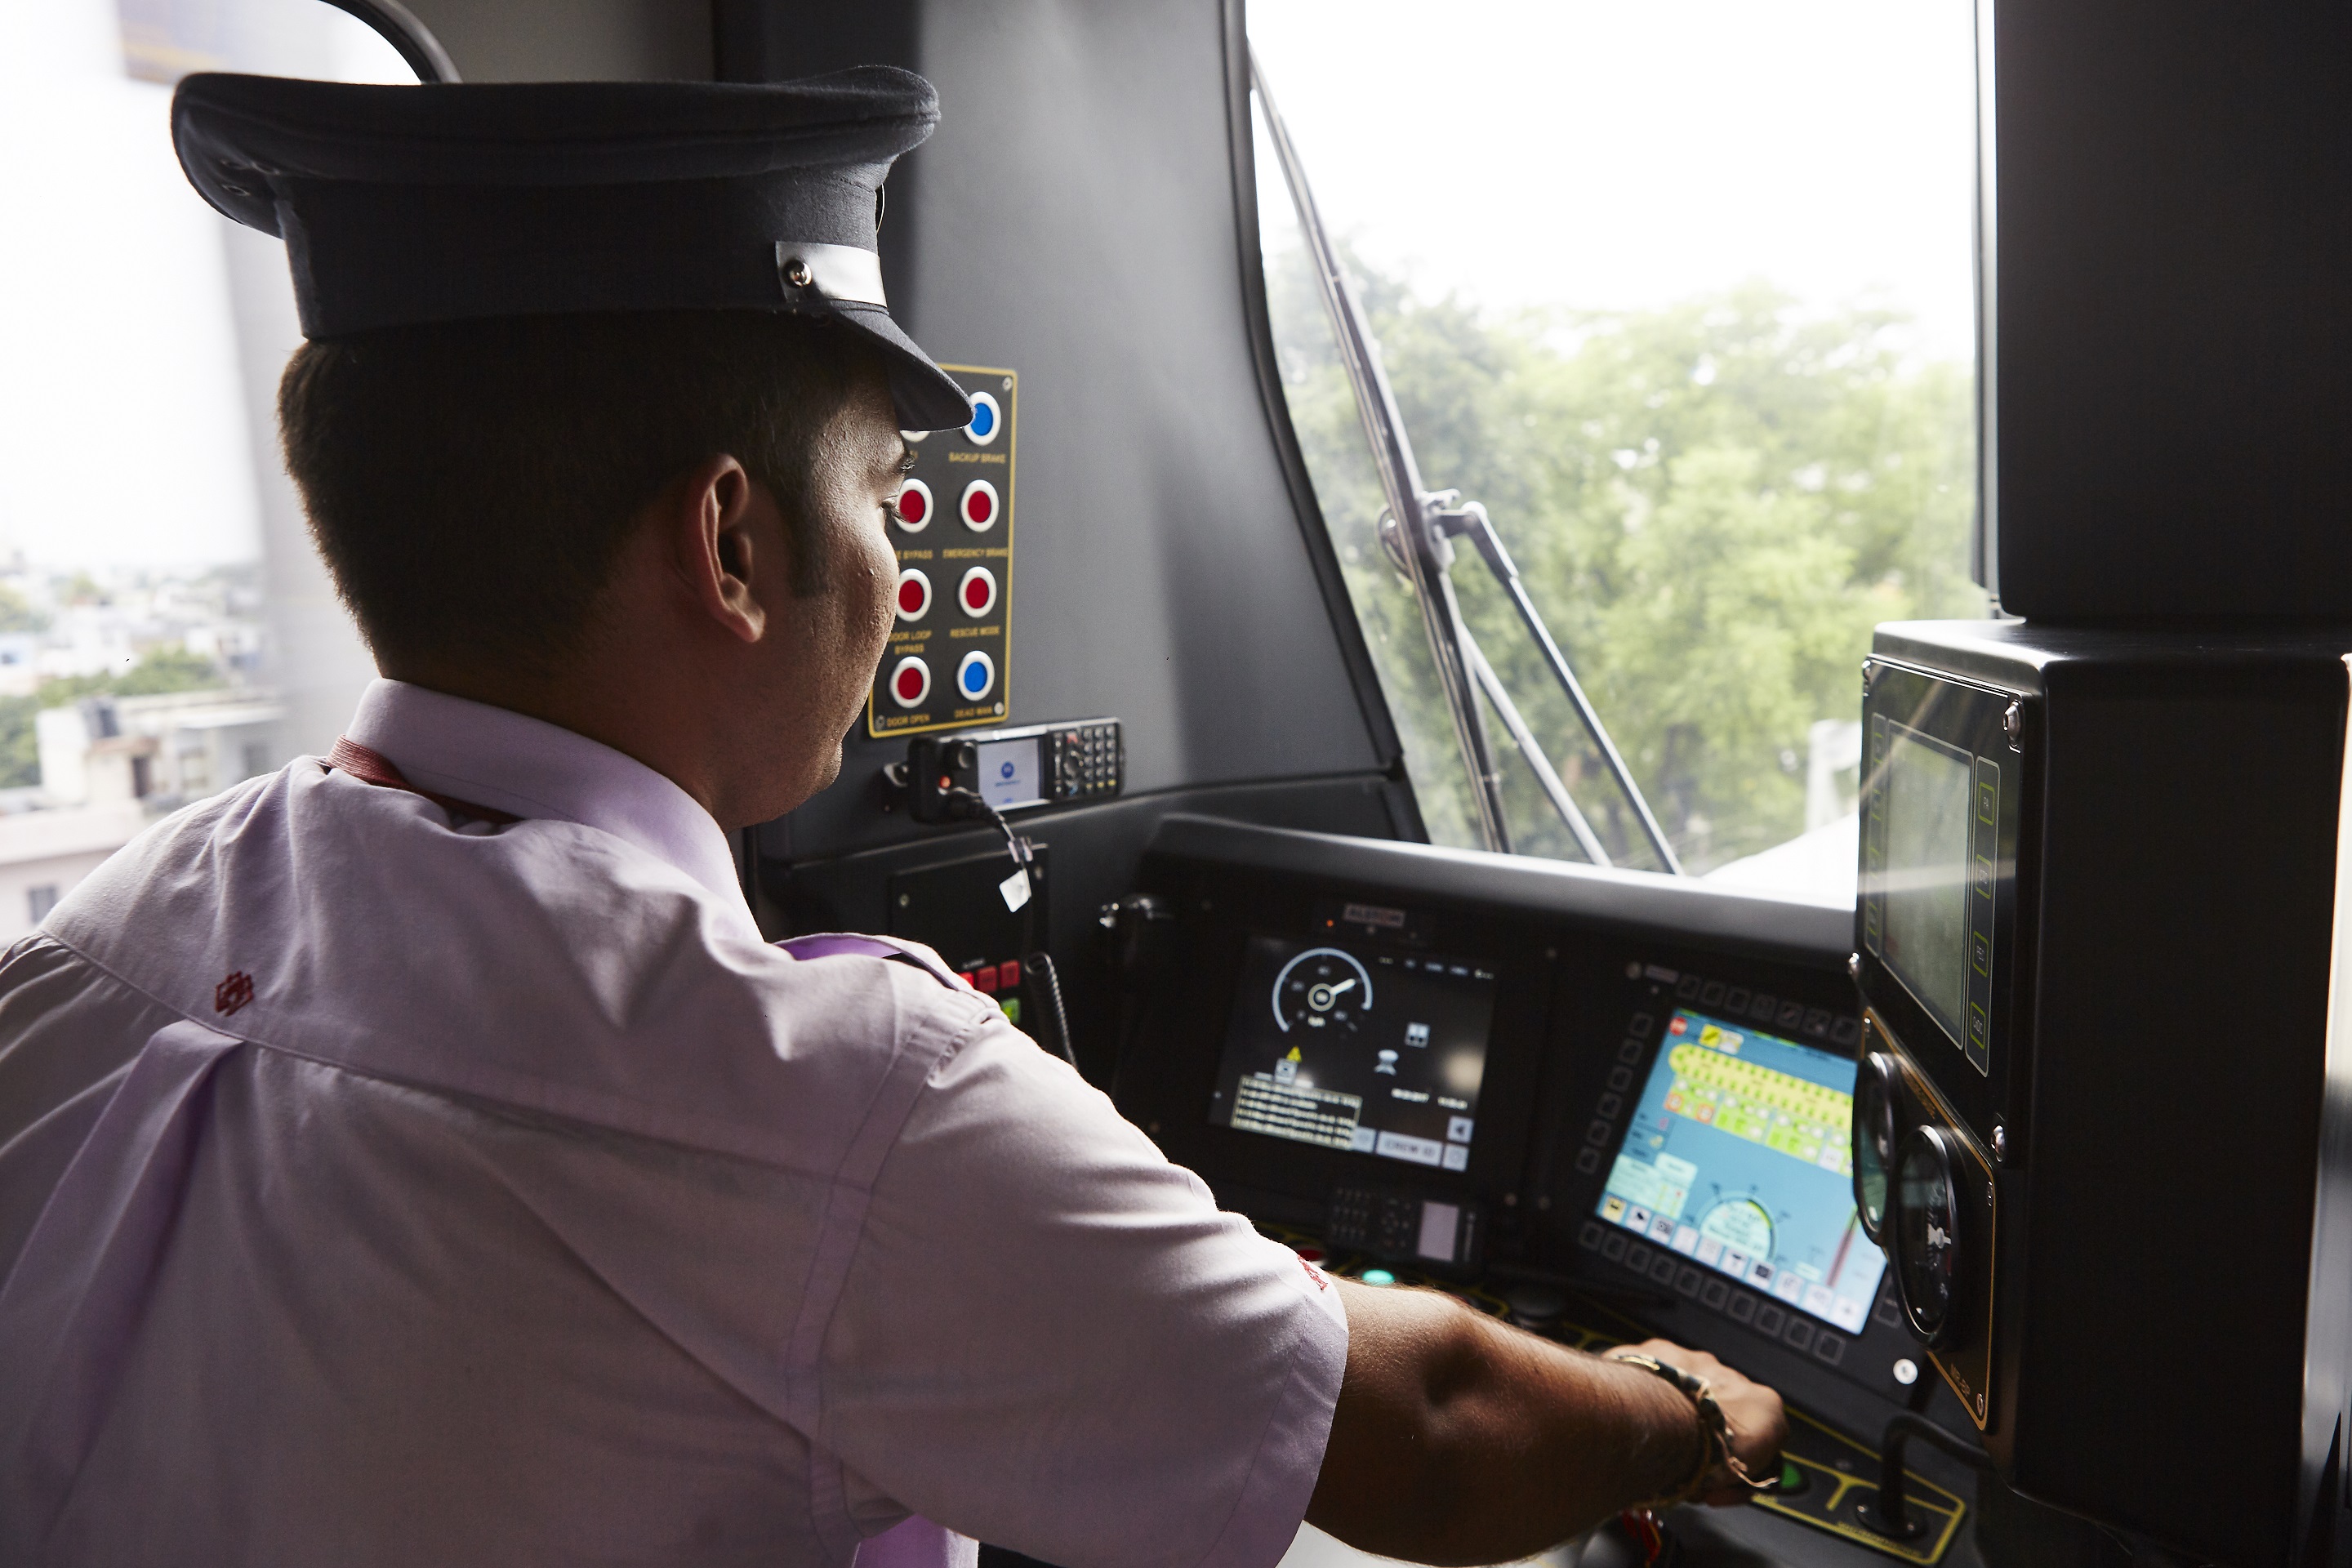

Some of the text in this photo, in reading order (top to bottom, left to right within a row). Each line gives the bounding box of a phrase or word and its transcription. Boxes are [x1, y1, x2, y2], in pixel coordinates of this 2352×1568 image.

[948, 452, 1006, 463] BACKUP BRAKE
[903, 549, 933, 560] BYPASS
[942, 548, 985, 559] EMERGENCY
[911, 630, 932, 641] LOOP
[949, 626, 1000, 638] RESCUE MODE
[894, 644, 924, 655] BYPASS
[886, 714, 931, 728] DOOR OPEN
